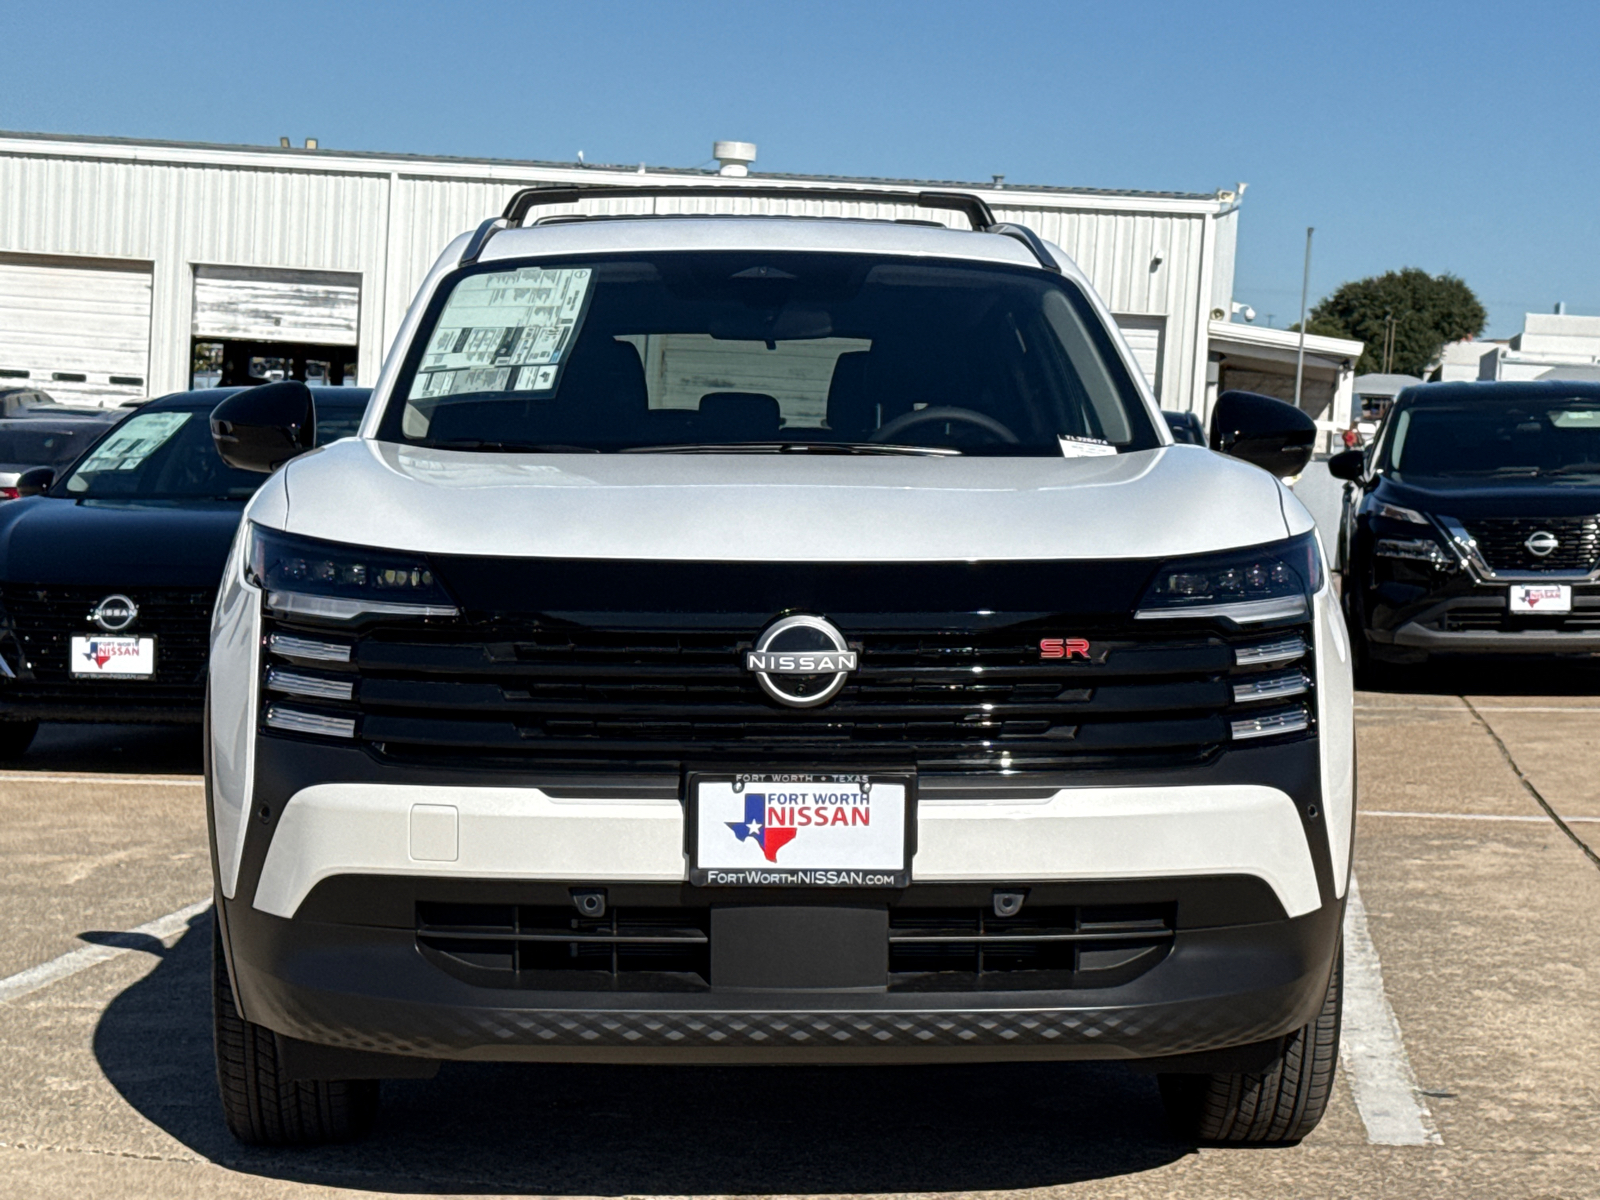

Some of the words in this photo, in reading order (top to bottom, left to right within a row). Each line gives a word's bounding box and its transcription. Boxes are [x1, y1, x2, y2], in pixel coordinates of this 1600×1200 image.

[95, 608, 137, 617] NISSAN
[99, 647, 139, 656] NISSAN
[1040, 638, 1091, 660] SR
[748, 655, 856, 671] NISSAN
[736, 774, 766, 782] FORT
[772, 774, 813, 783] WORTH
[832, 775, 869, 783] TEXAS
[768, 793, 808, 805] FORT
[813, 793, 870, 805] WORTH
[768, 806, 870, 826] NISSAN
